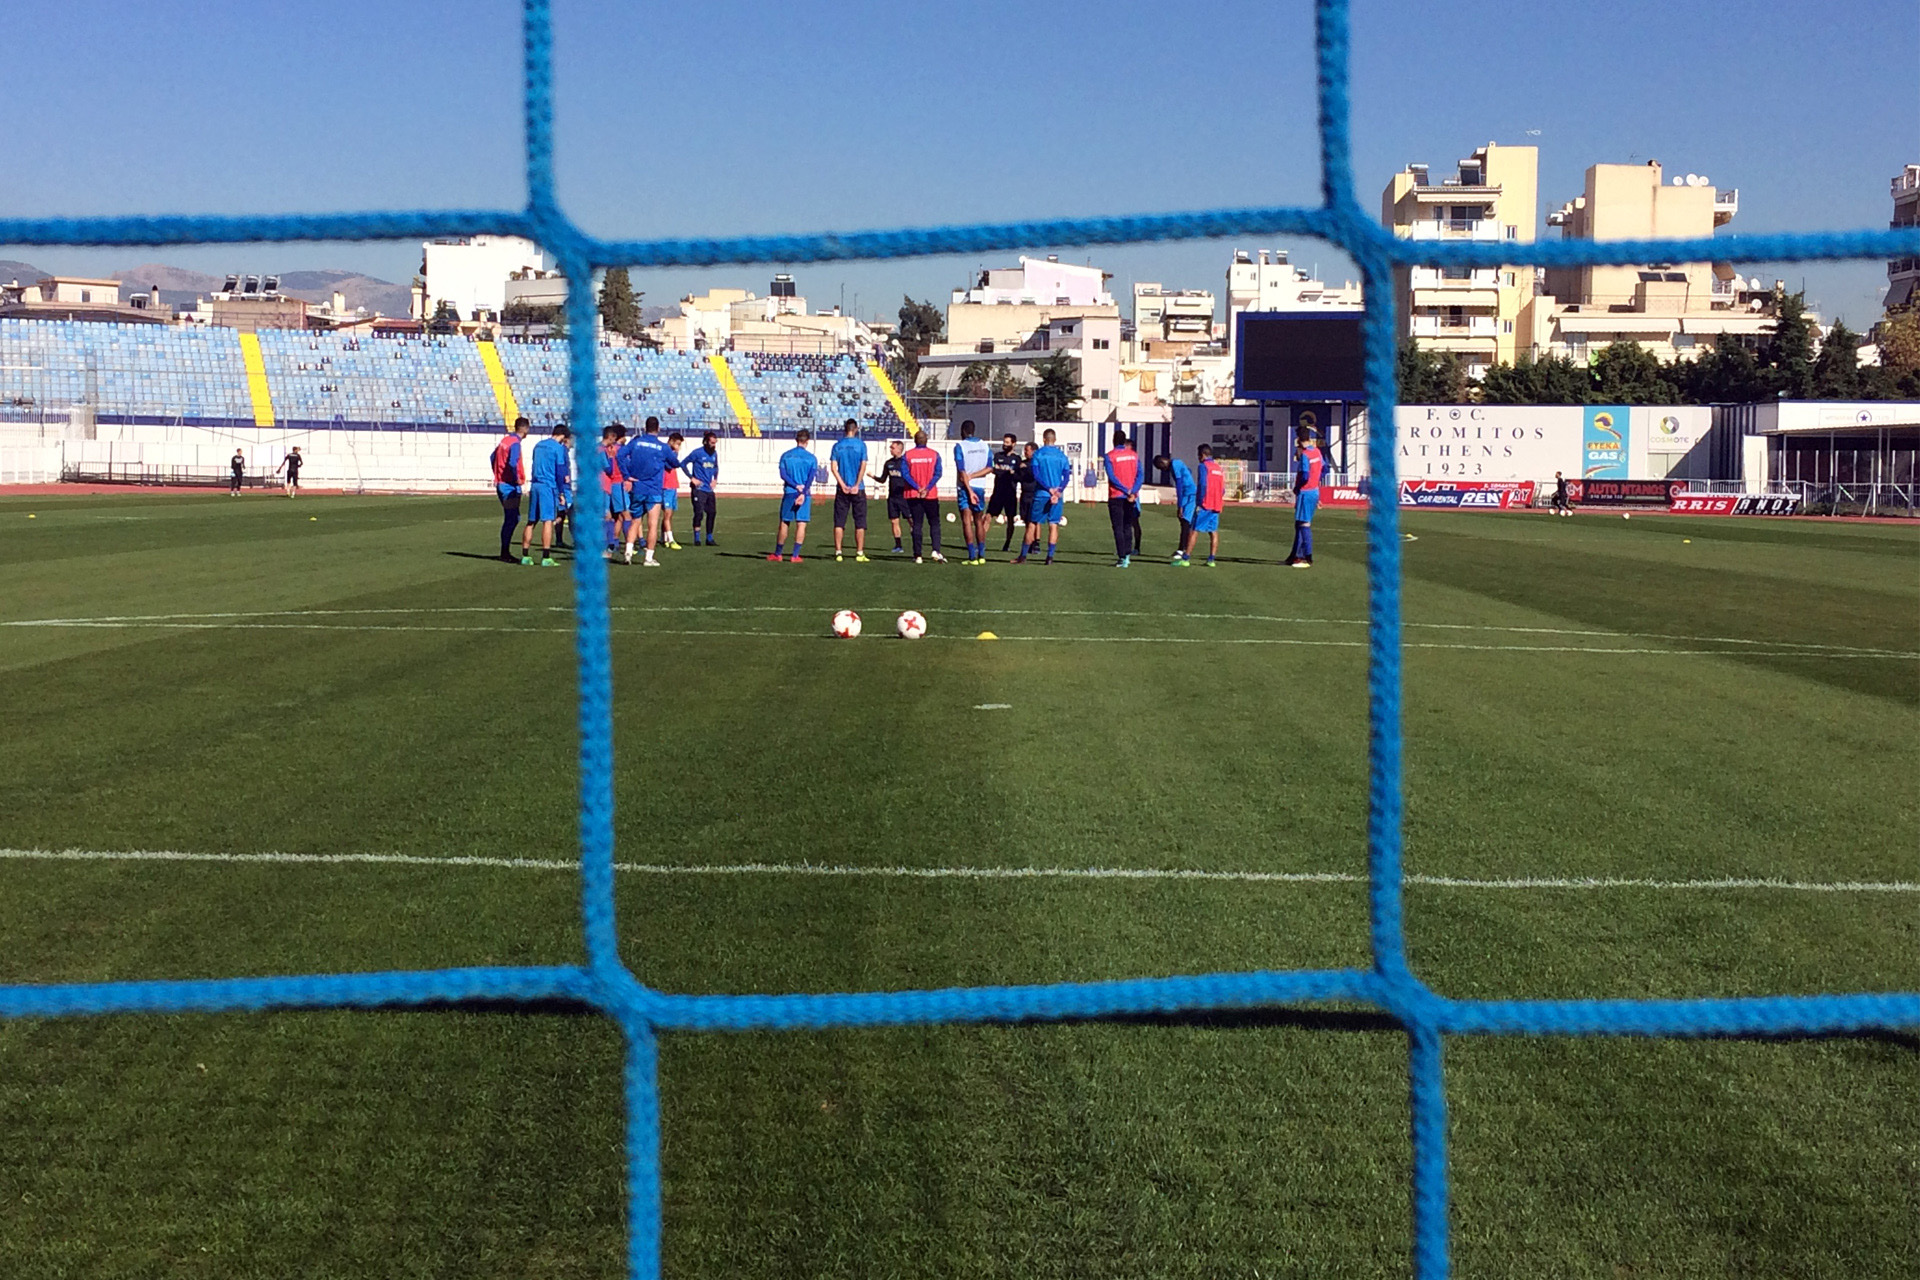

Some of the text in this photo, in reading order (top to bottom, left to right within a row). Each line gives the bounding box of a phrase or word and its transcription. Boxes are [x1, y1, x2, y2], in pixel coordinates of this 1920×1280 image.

[1426, 408, 1485, 421] F. C.
[1394, 426, 1544, 440] TROMITOS
[1650, 436, 1690, 444] COSMOTE
[1398, 444, 1513, 458] ATHENS
[1588, 451, 1618, 460] GAS
[1426, 462, 1483, 475] 1923
[1588, 483, 1618, 495] AUTO
[1417, 495, 1458, 504] CAR RENTAL
